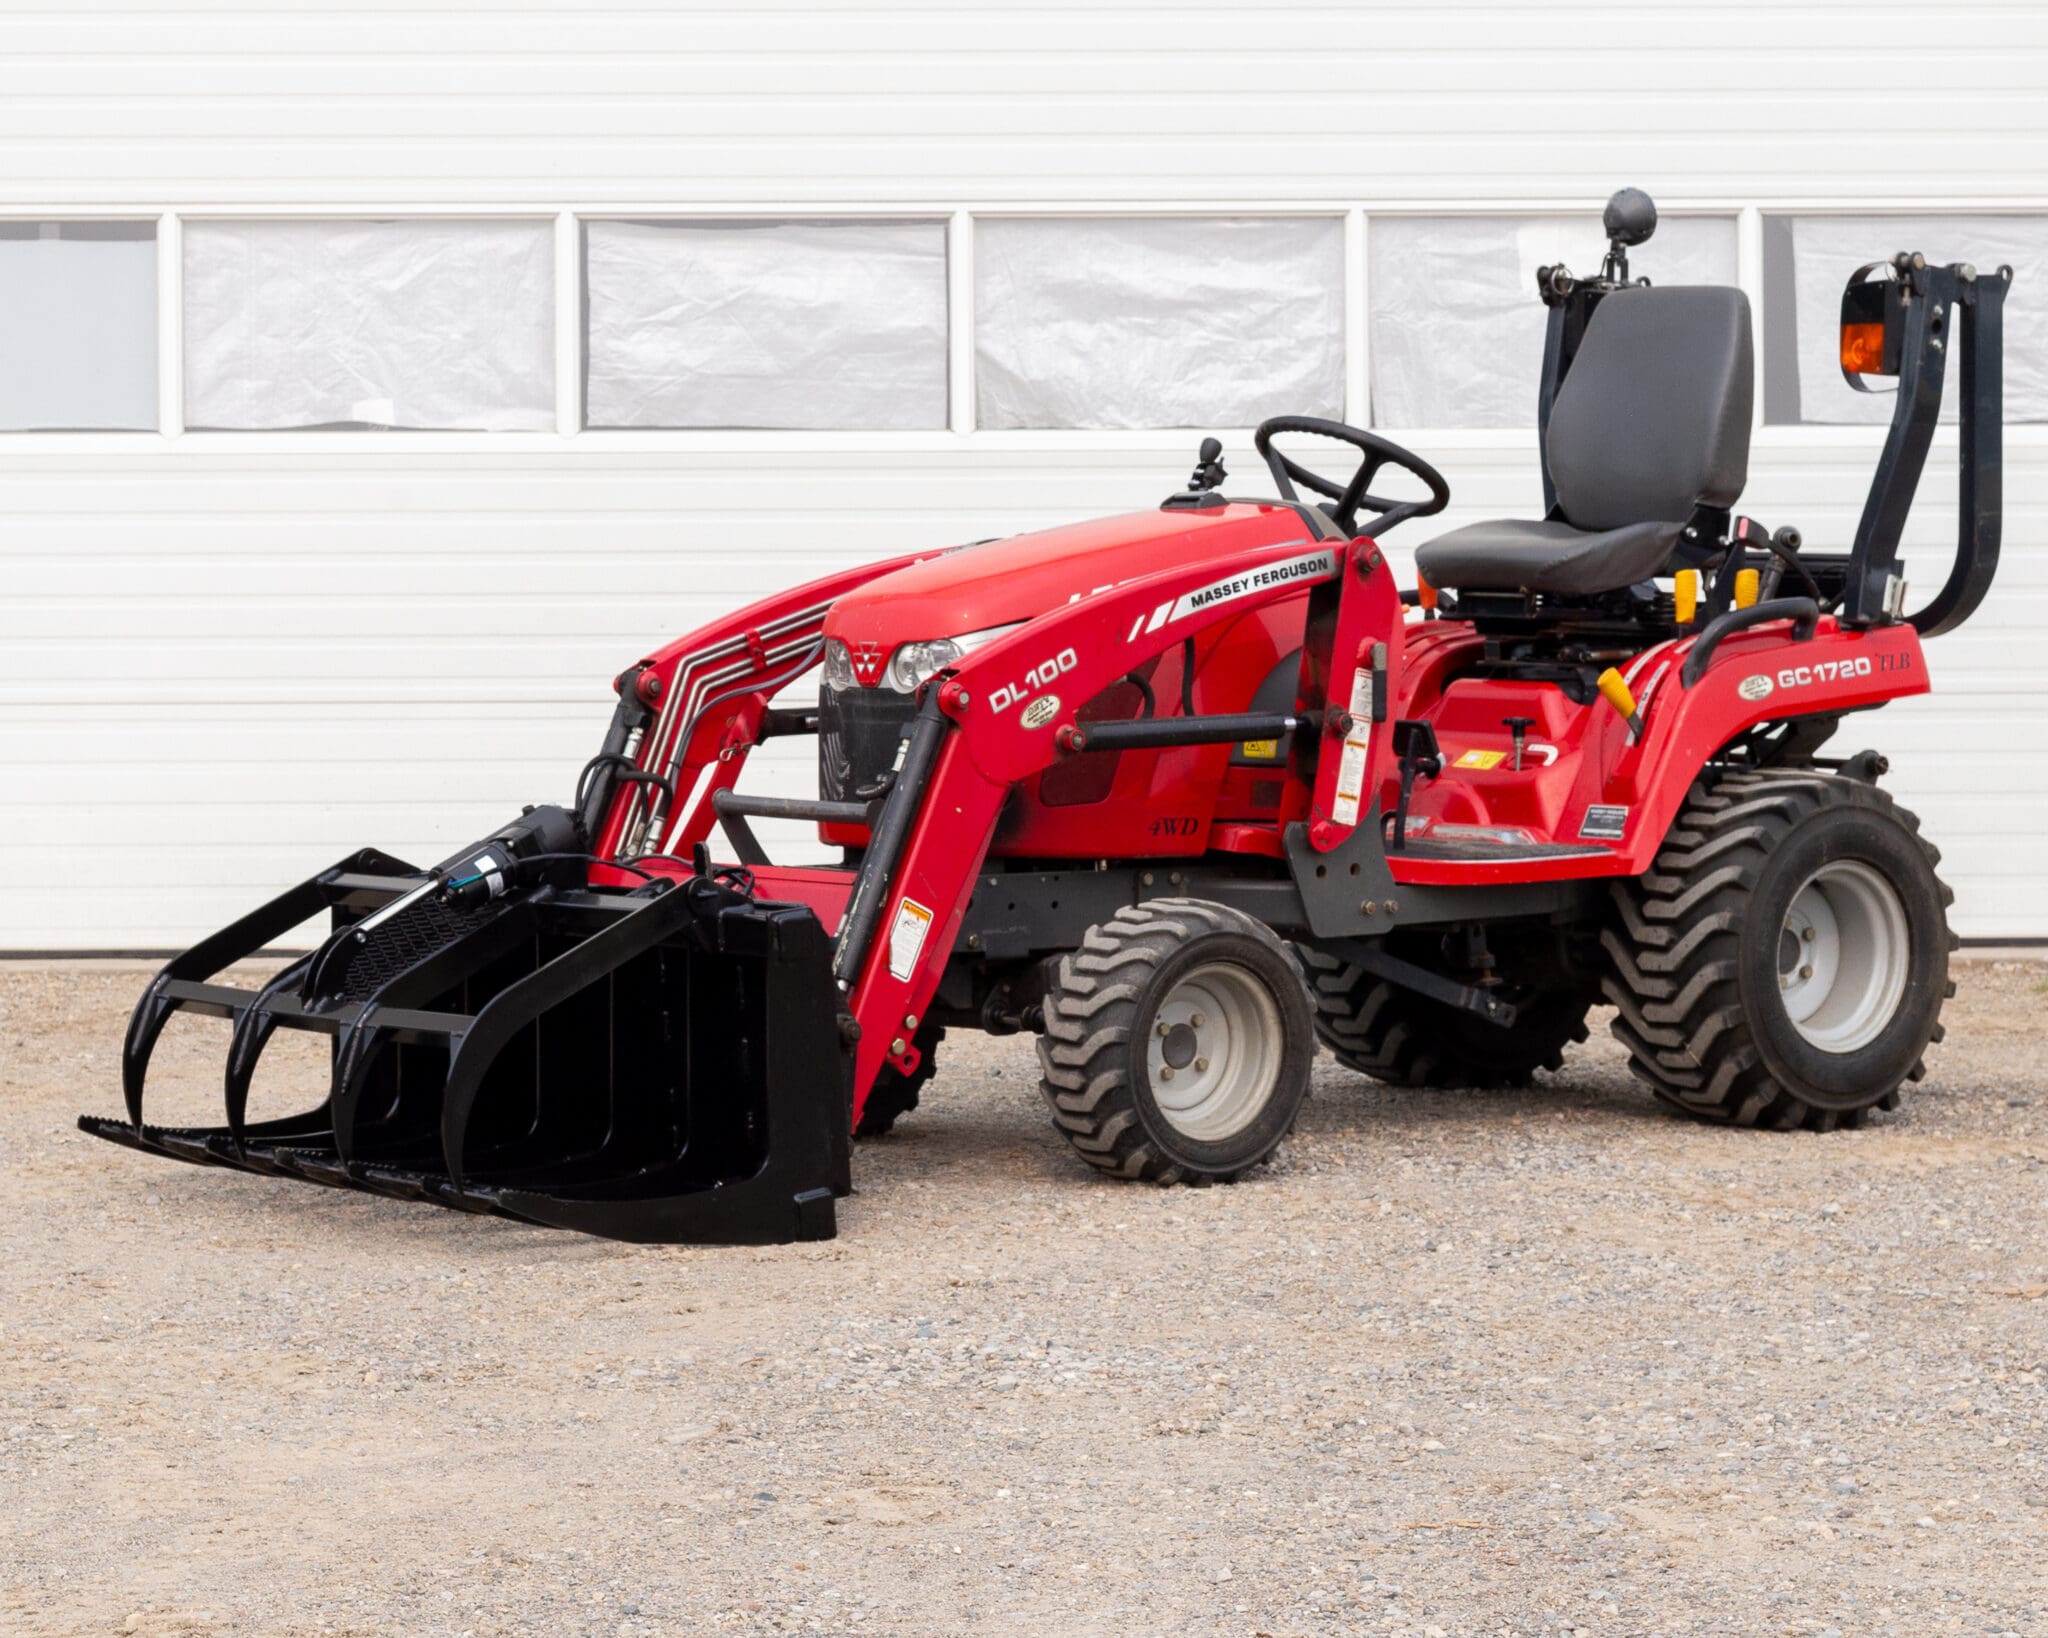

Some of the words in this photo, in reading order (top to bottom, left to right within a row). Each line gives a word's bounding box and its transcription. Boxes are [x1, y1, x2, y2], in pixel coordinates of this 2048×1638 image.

[1191, 578, 1249, 607] MASSEY
[1253, 557, 1328, 586] FERGUSON
[1876, 652, 1911, 672] TLB
[1147, 816, 1199, 836] 4WD
